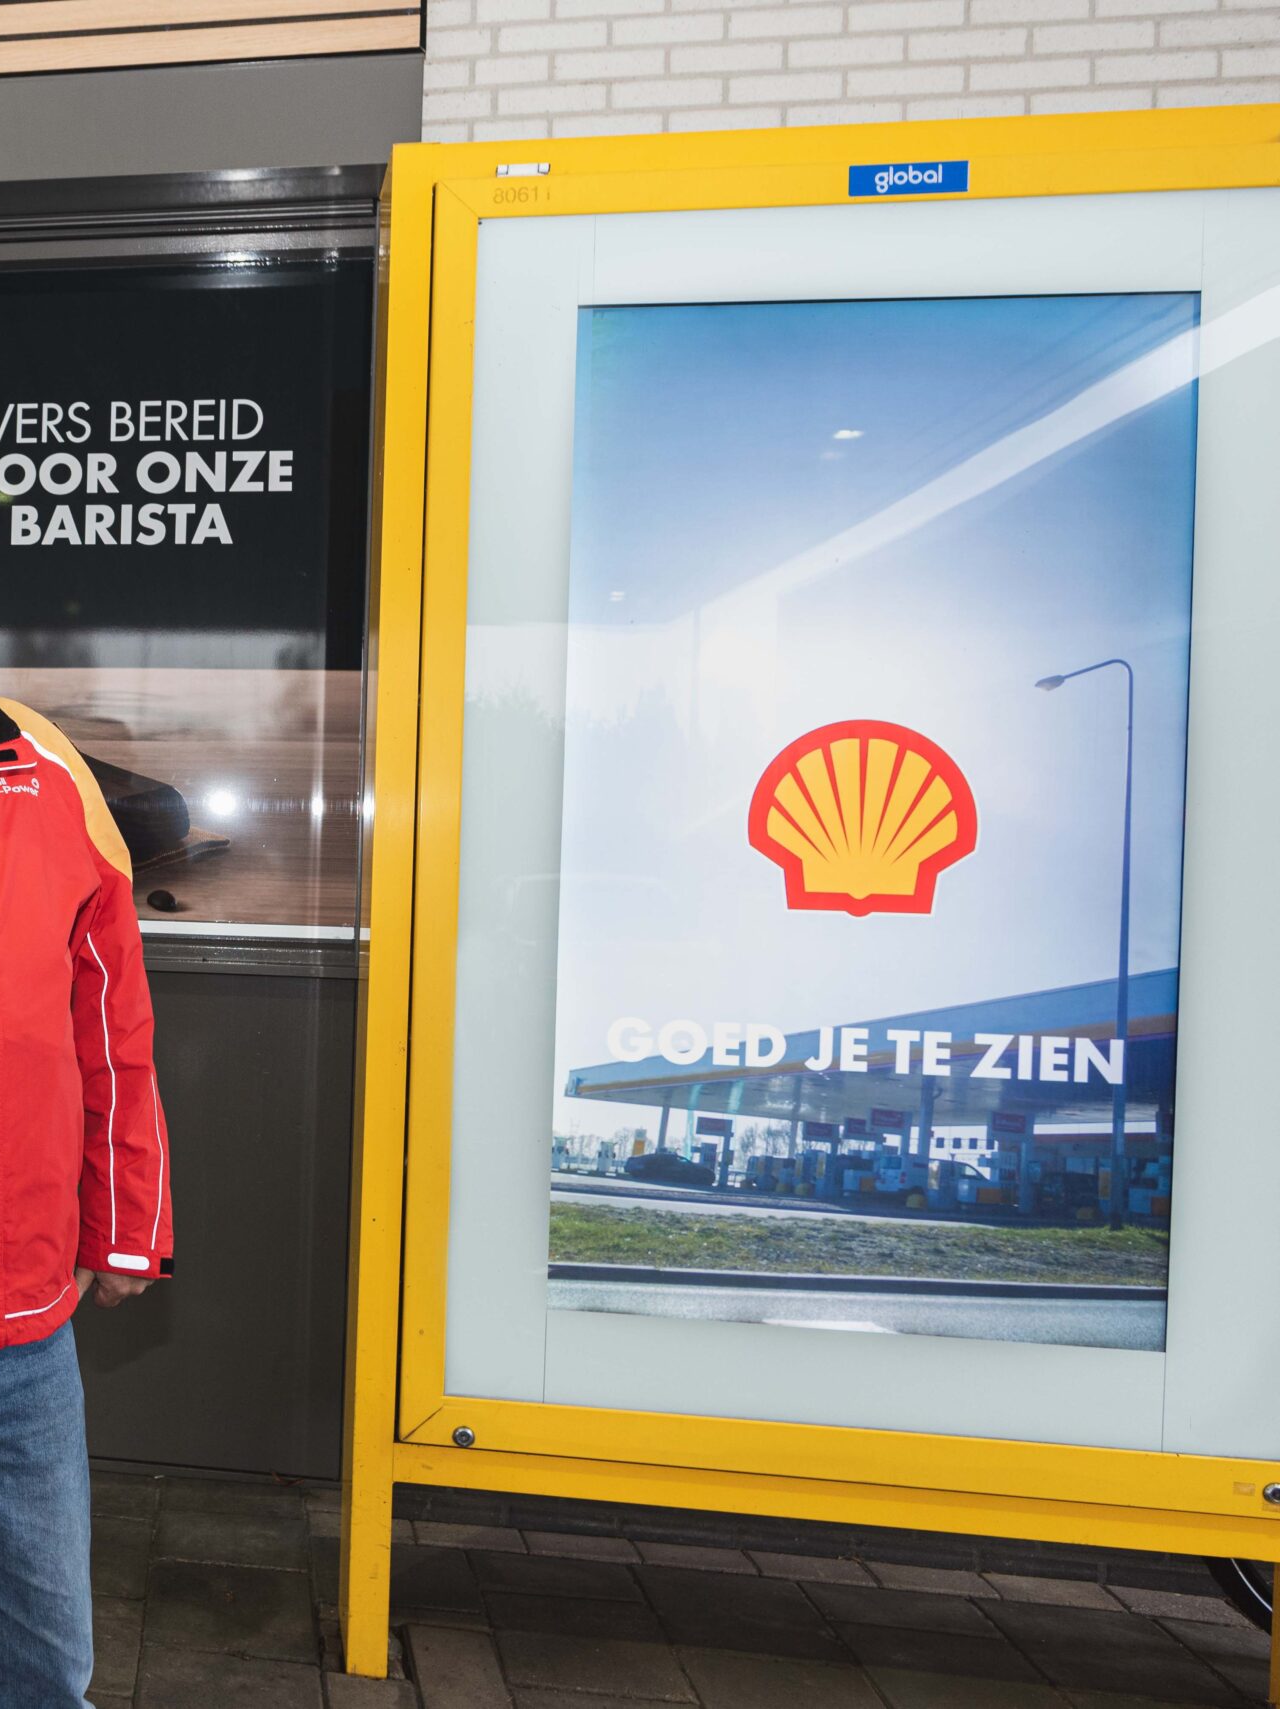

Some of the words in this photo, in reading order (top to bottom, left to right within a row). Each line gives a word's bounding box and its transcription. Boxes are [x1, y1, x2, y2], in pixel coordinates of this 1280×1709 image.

[874, 163, 943, 194] global
[110, 398, 264, 442] BEREID
[136, 450, 294, 494] ONZE
[10, 503, 234, 546] BARISTA
[606, 1016, 787, 1068] GOED
[804, 1026, 869, 1073] JE
[886, 1029, 952, 1077] TE
[969, 1033, 1125, 1085] ZIEN
